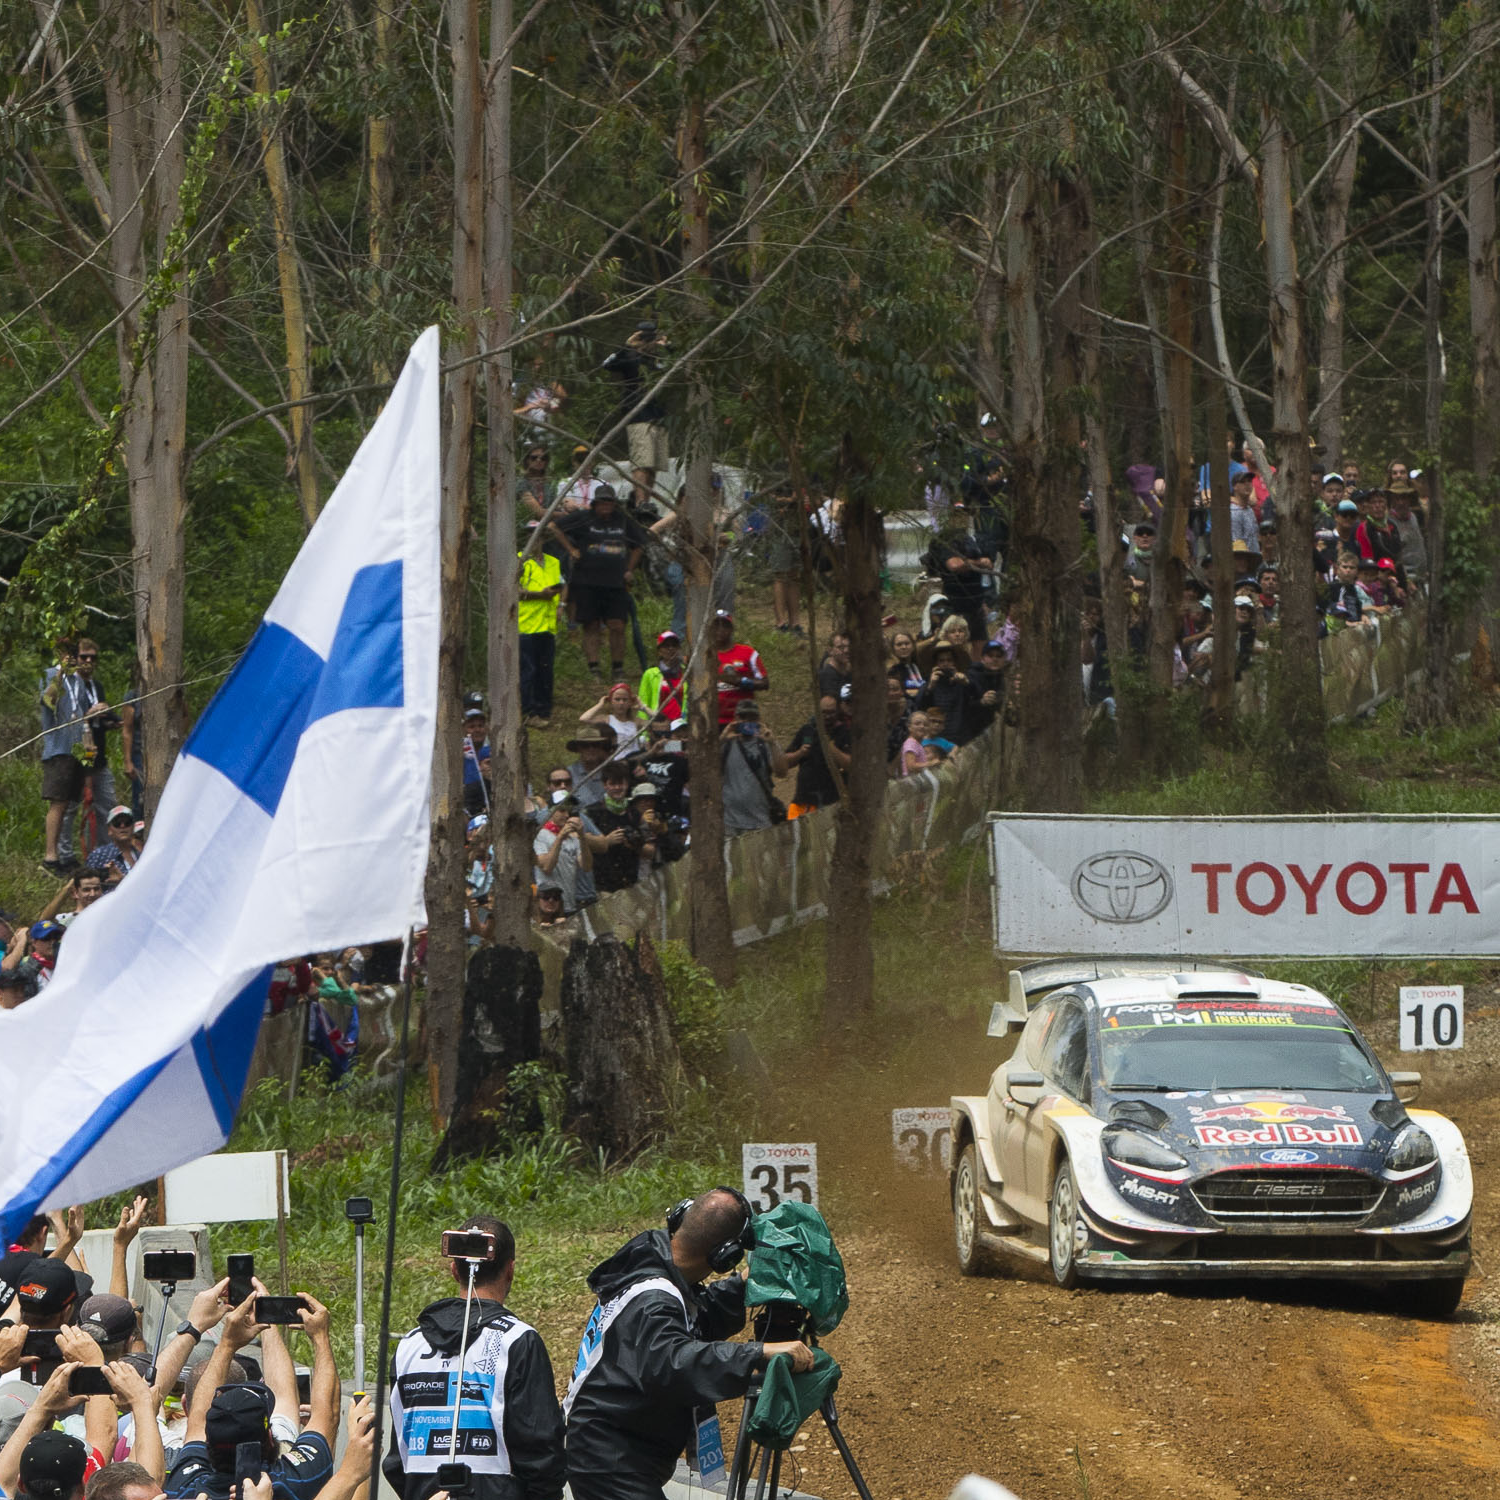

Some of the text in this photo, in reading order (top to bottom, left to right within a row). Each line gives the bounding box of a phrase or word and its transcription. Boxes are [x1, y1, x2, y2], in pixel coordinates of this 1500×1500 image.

[1191, 861, 1481, 916] TOYOTA
[1421, 990, 1457, 998] TOYOTA
[1115, 1002, 1338, 1016] FORD PERFORMANCE
[1214, 1015, 1296, 1025] INSURANCE
[1407, 1003, 1458, 1046] 10
[1200, 1126, 1360, 1145] Red Bull
[767, 1148, 810, 1157] TOYOTA
[1270, 1150, 1307, 1163] Ford
[750, 1165, 812, 1214] 35
[1253, 1184, 1325, 1195] Fiesta
[414, 1416, 451, 1425] NOVEMBER
